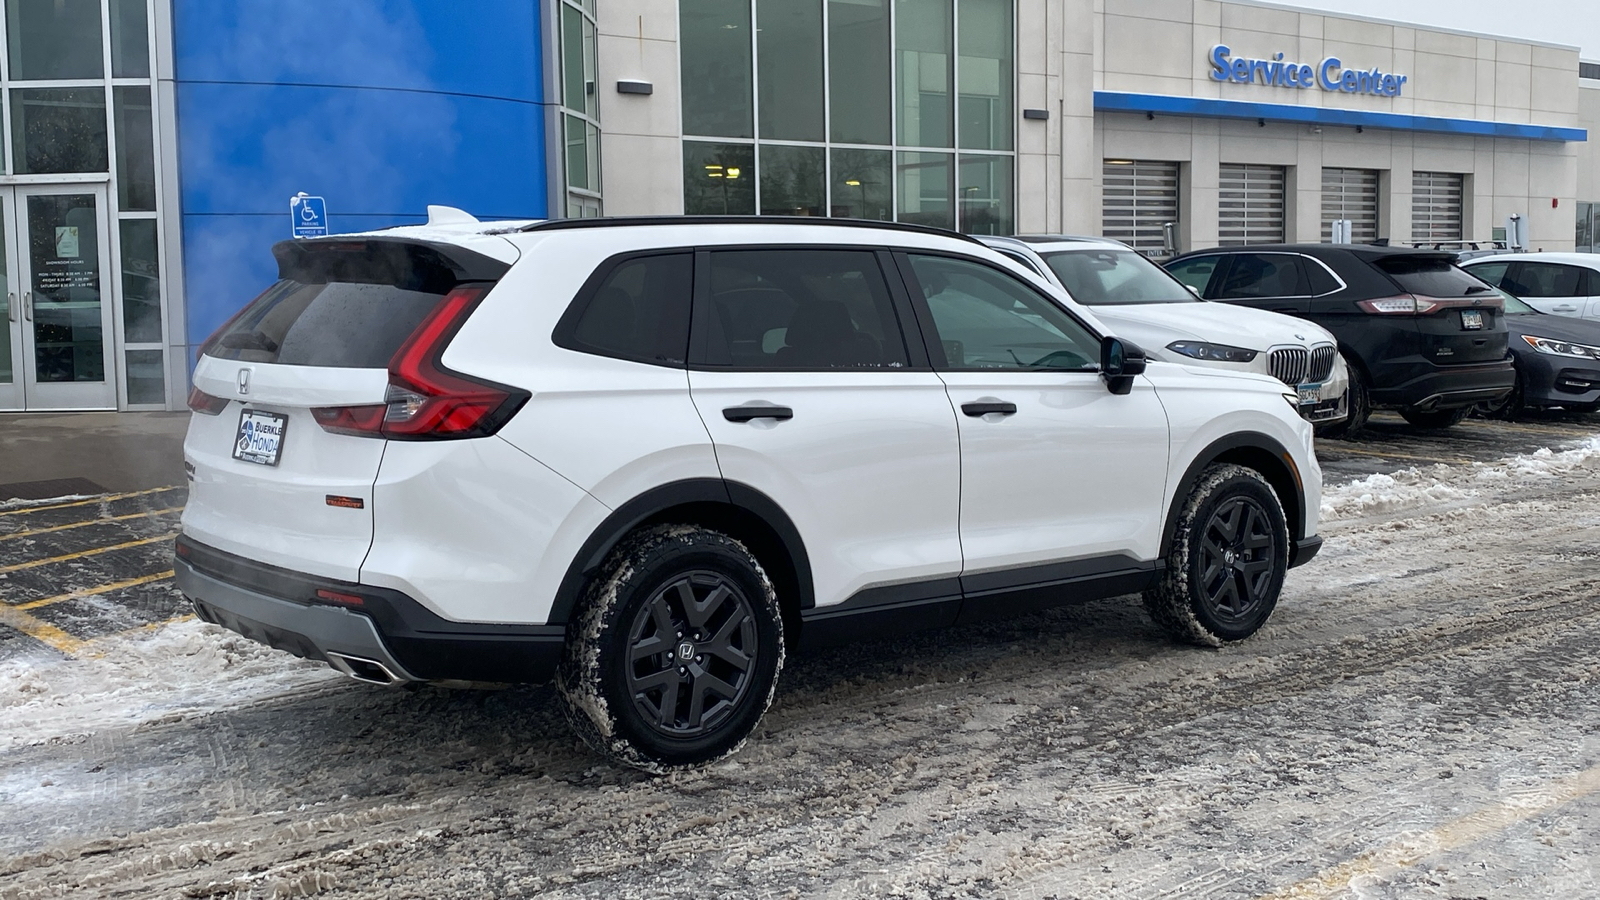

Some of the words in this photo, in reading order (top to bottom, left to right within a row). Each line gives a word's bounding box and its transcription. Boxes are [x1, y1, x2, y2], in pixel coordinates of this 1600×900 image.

[1209, 44, 1314, 89] Service
[1316, 56, 1408, 97] Center
[255, 421, 283, 436] BUERKLE
[251, 433, 279, 453] HONDA
